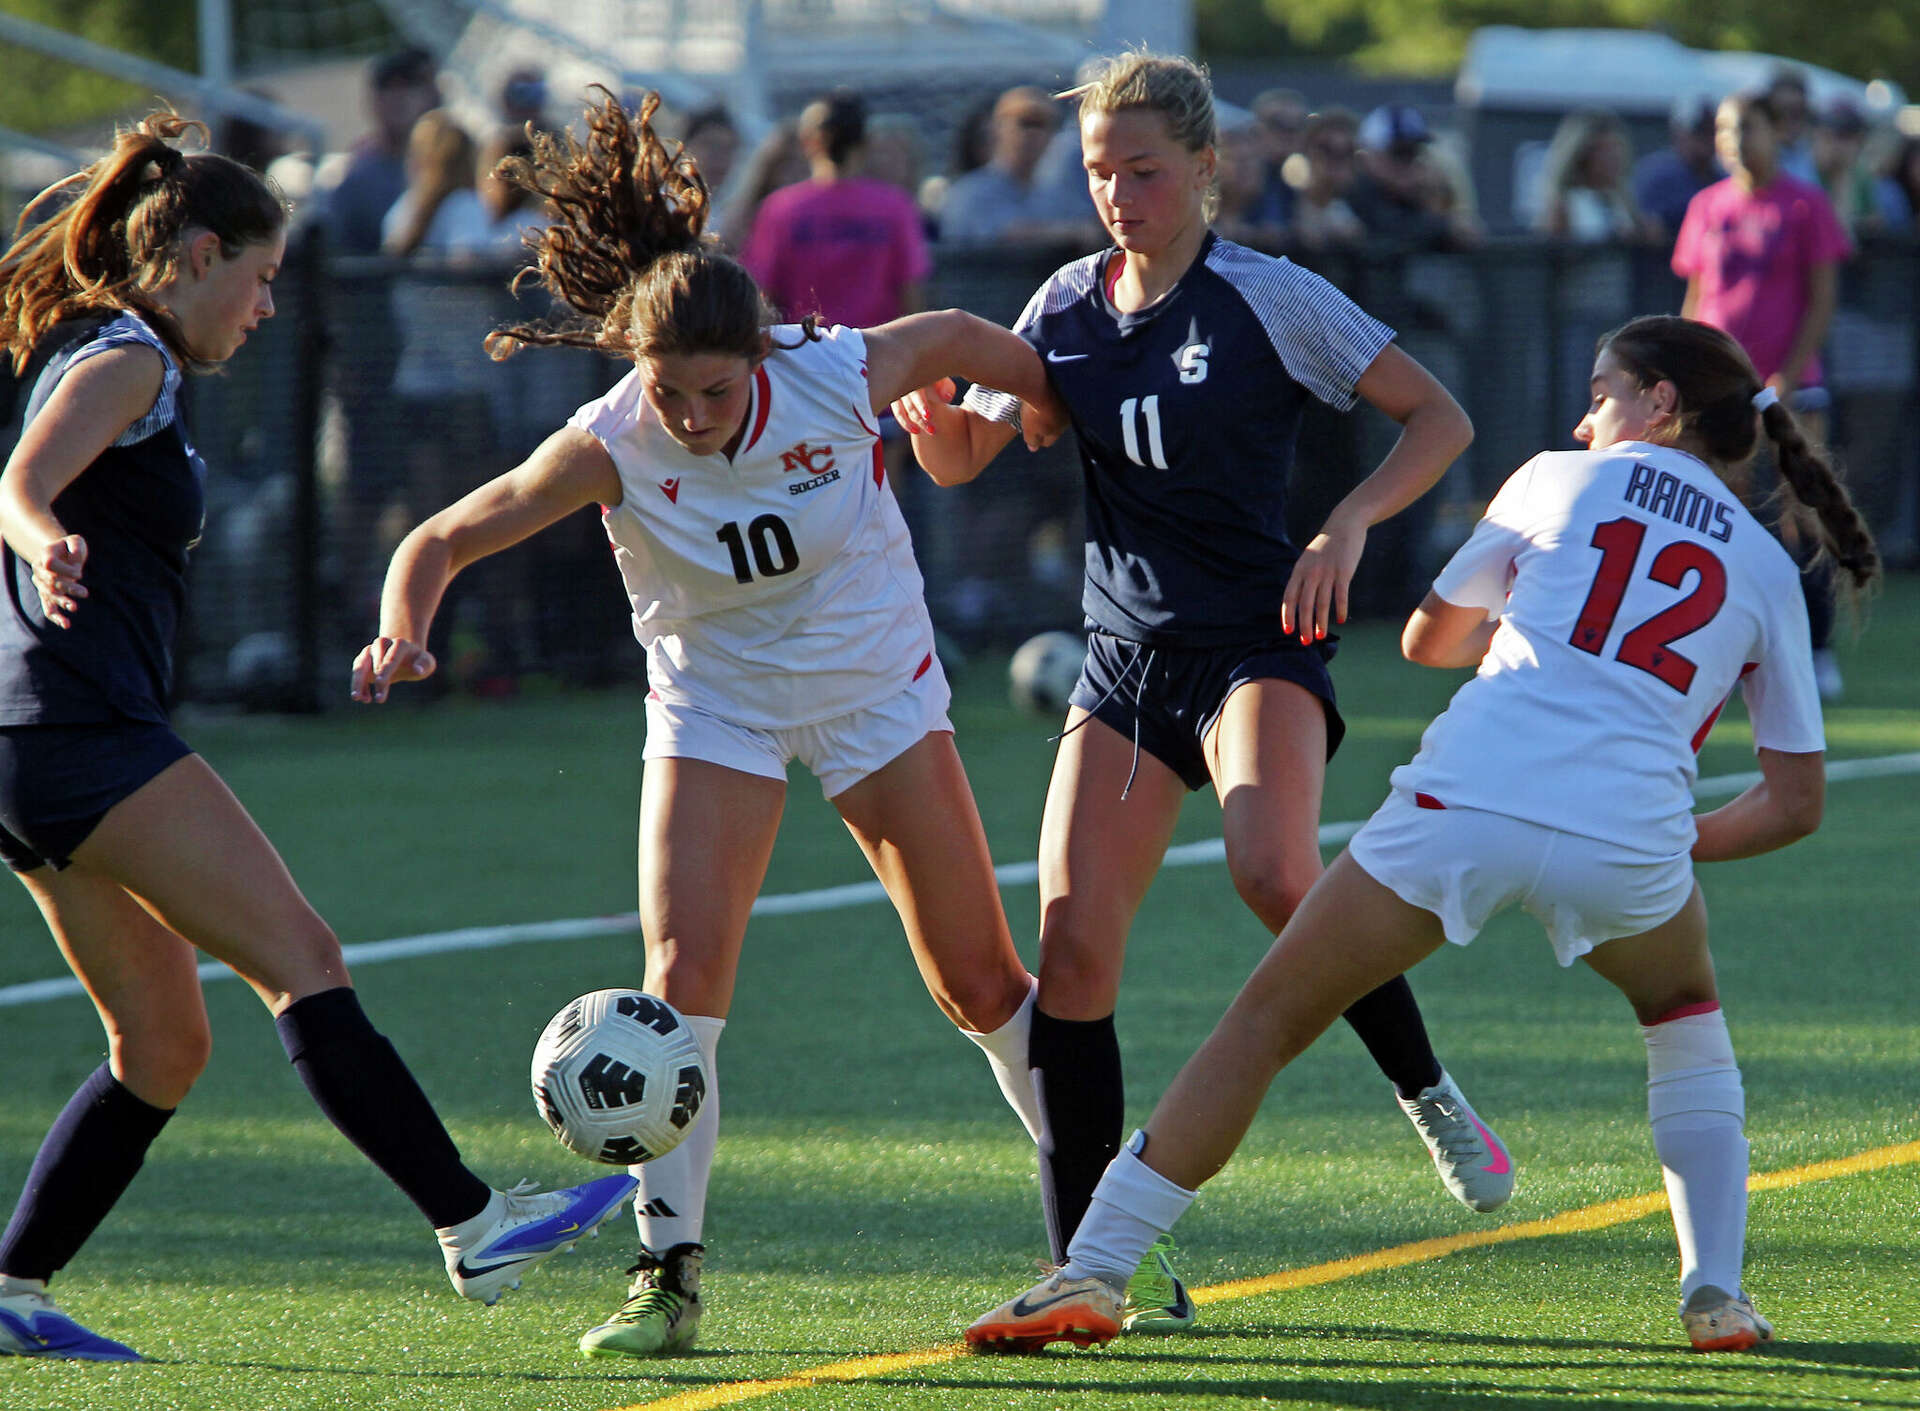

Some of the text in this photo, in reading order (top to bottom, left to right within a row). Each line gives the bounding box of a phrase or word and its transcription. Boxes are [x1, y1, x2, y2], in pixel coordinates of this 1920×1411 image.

[1179, 343, 1210, 384] S
[779, 443, 836, 474] NC
[1119, 394, 1169, 470] 11
[788, 469, 841, 496] SOCCER
[1623, 462, 1736, 544] RAMS
[715, 513, 800, 584] 10
[1568, 515, 1728, 697] 12
